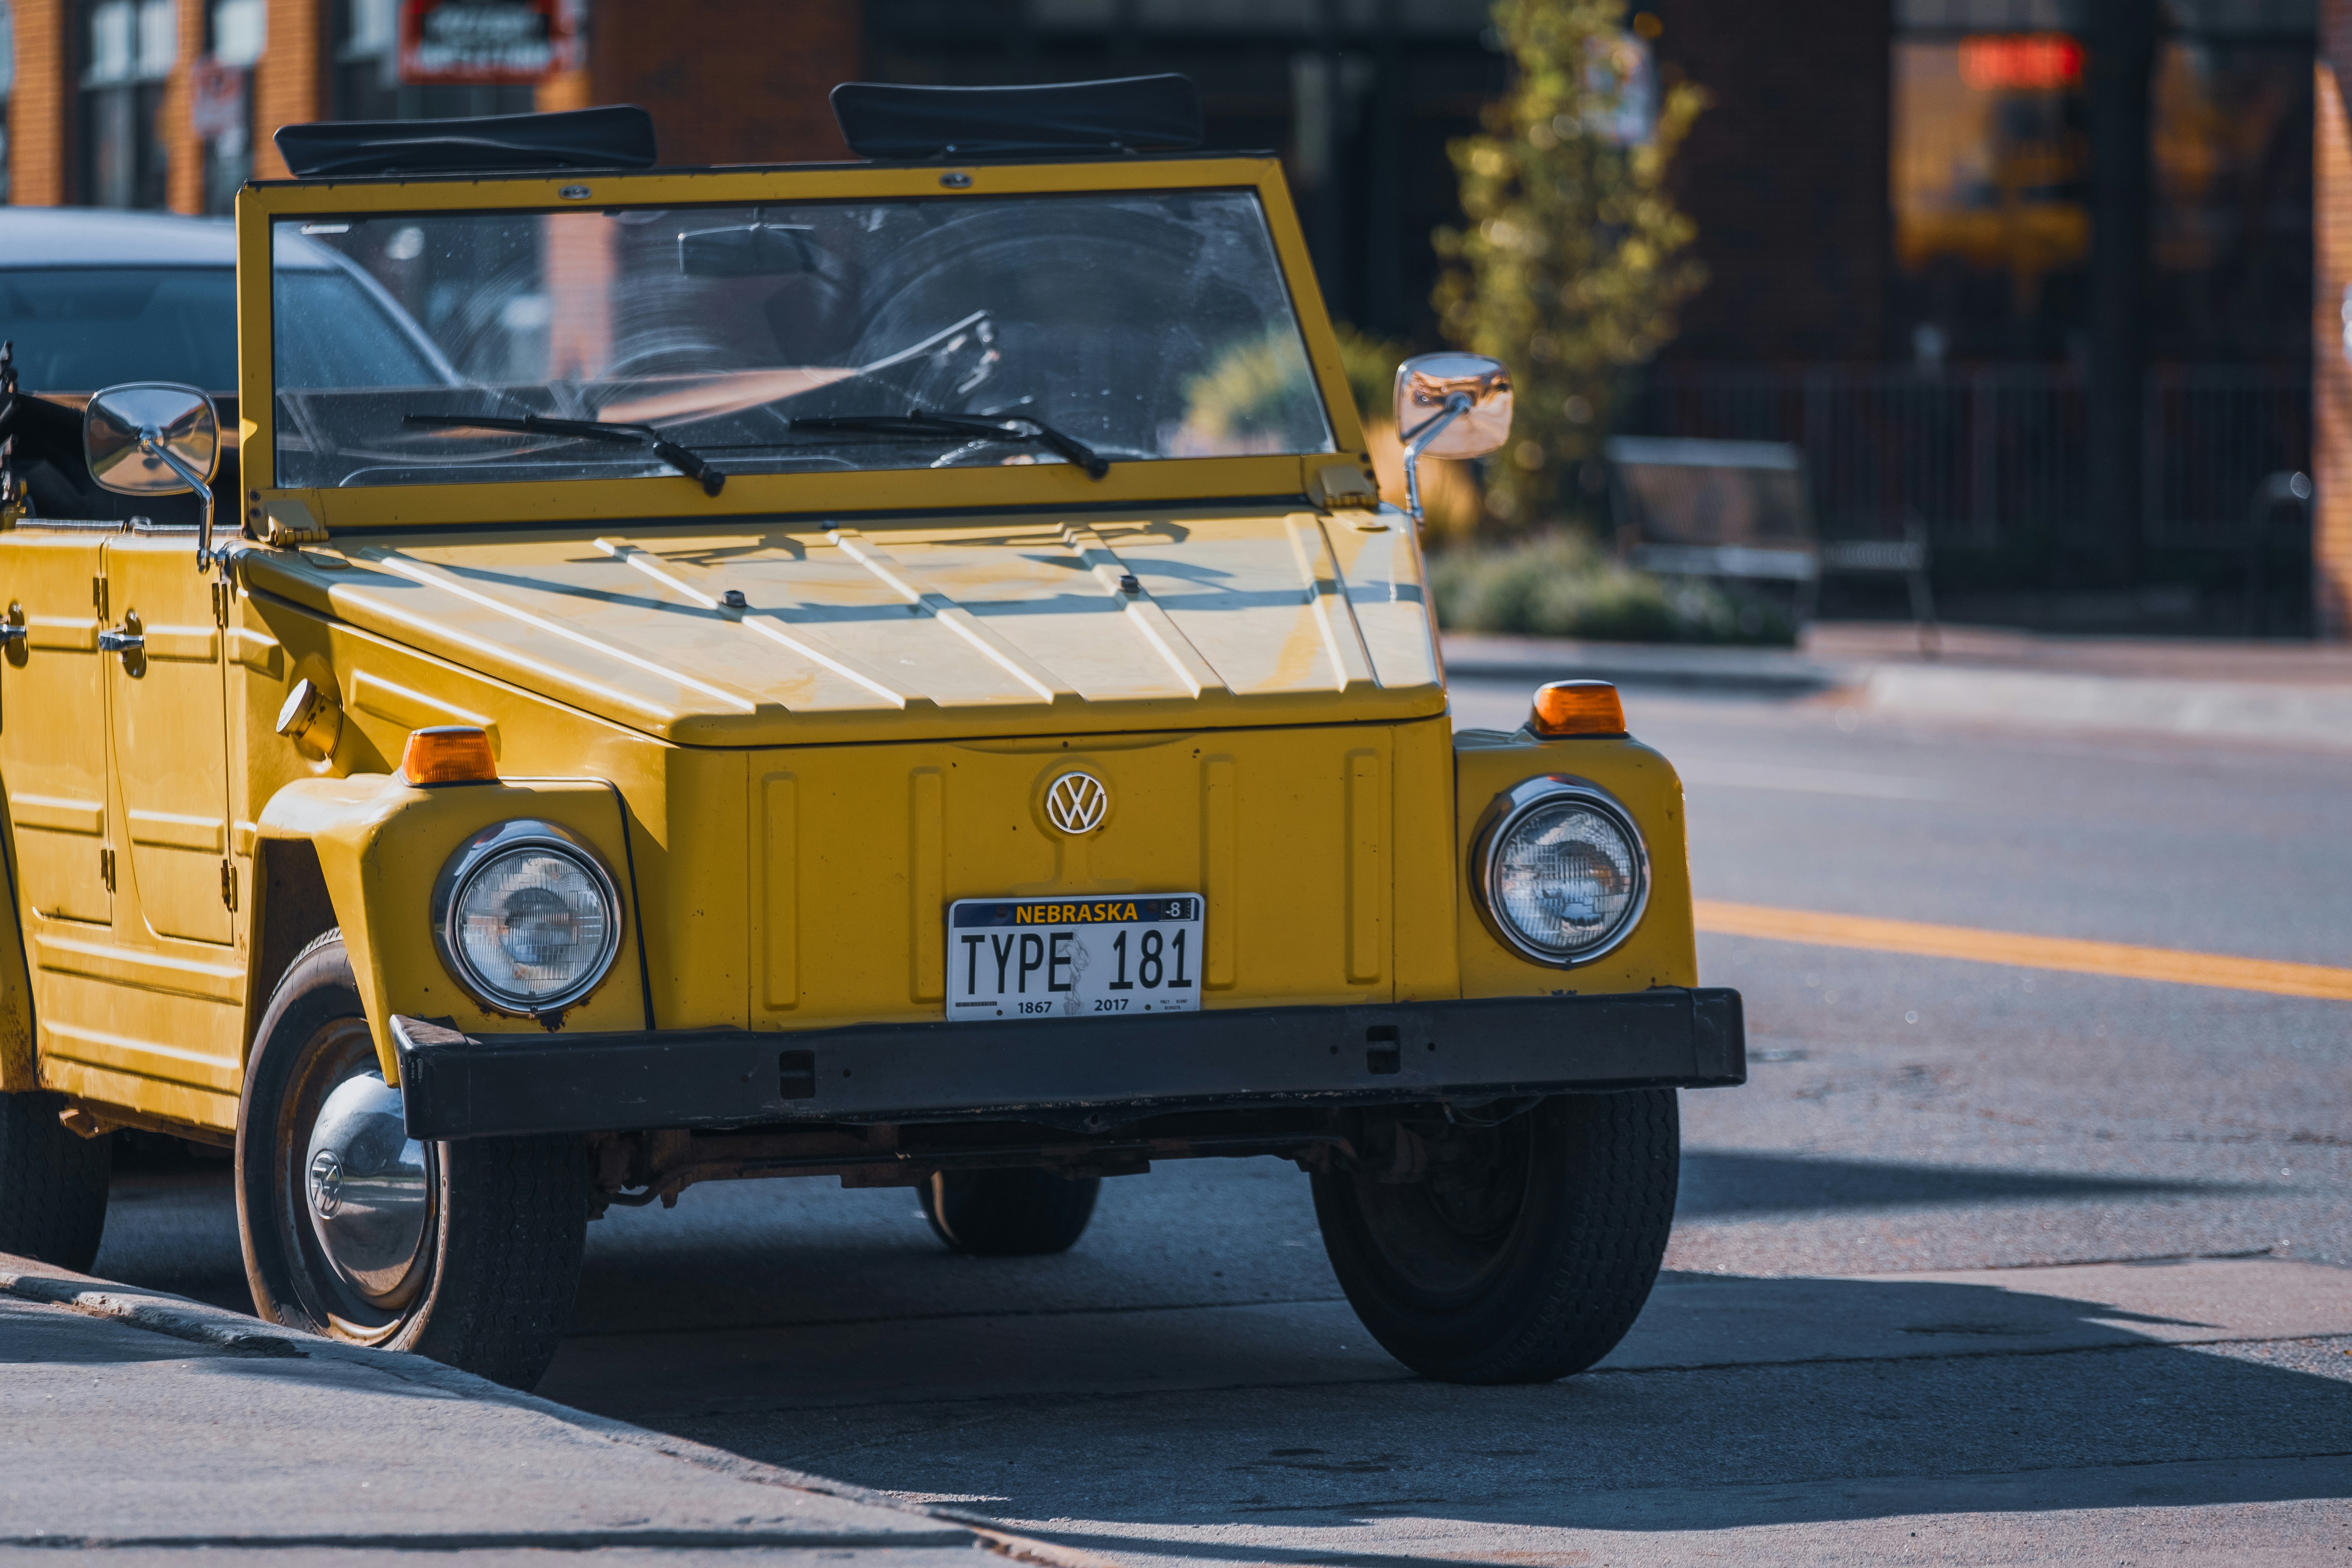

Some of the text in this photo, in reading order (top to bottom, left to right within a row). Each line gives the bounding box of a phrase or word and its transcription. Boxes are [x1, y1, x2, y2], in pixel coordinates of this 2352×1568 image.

[1049, 773, 1105, 832] VW
[1016, 903, 1138, 923] NEBRASKA
[961, 929, 1192, 995] TYPE 181
[1018, 999, 1129, 1014] 1867 2017
